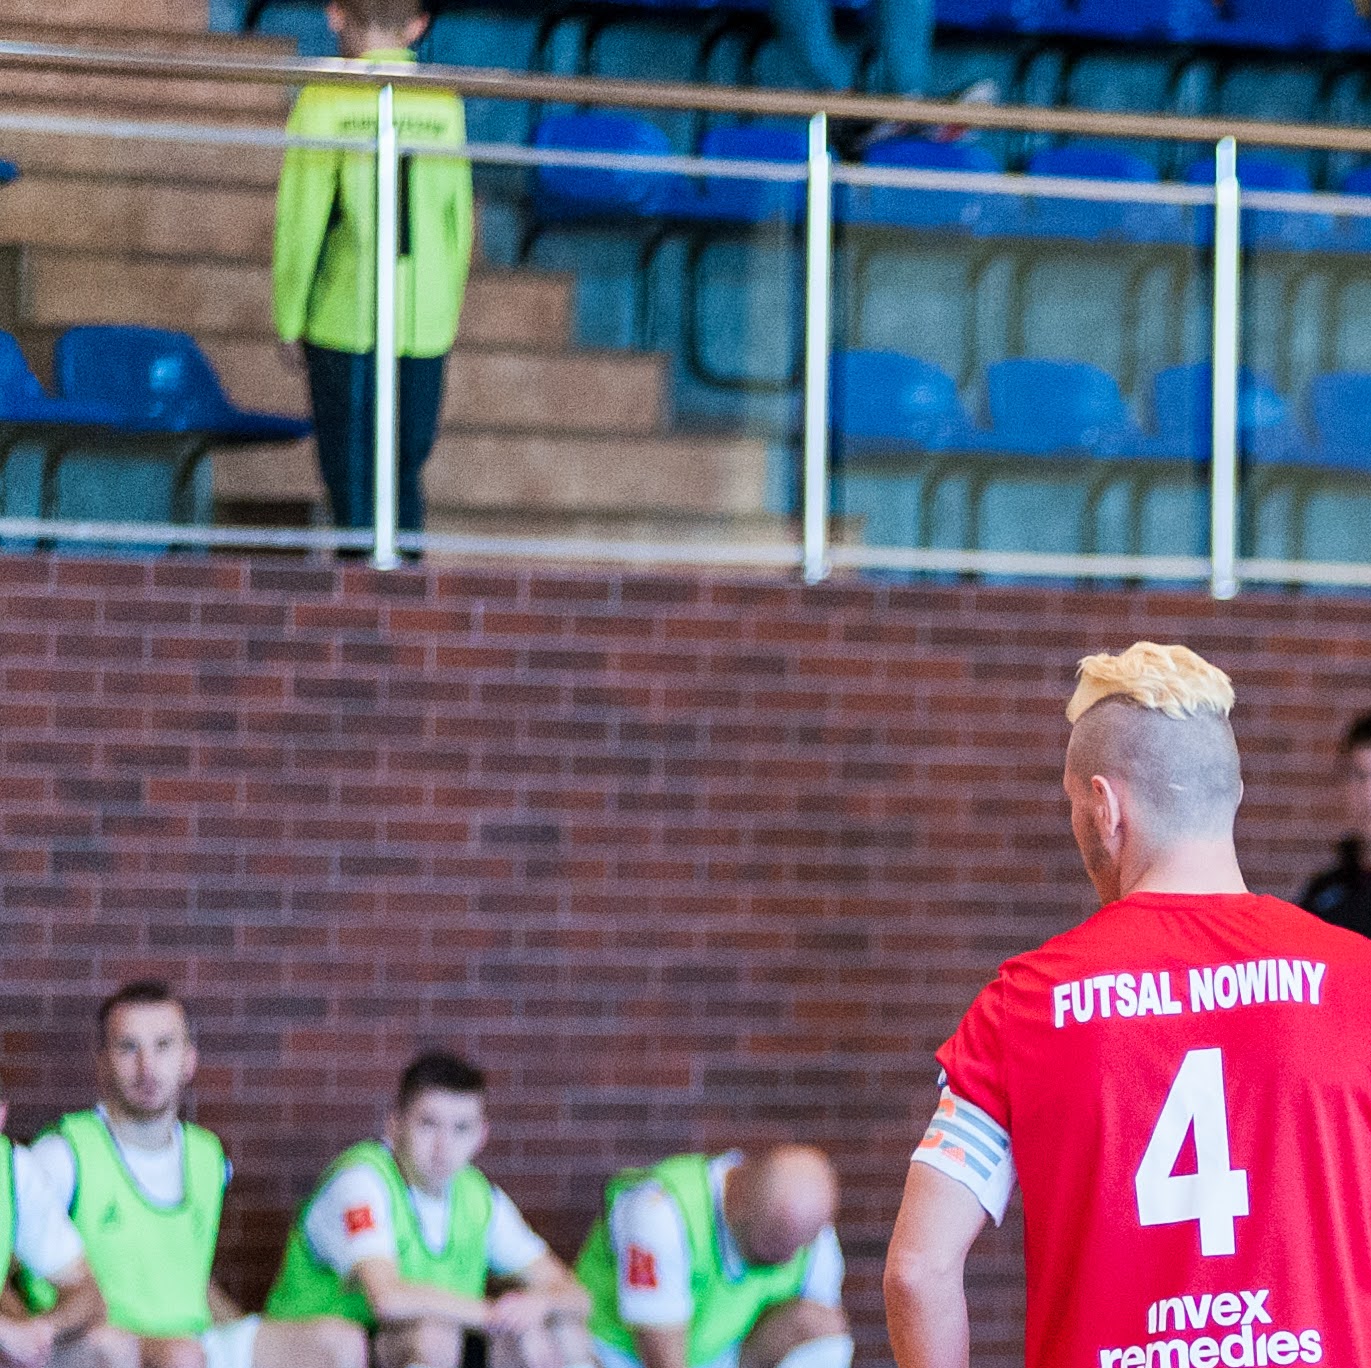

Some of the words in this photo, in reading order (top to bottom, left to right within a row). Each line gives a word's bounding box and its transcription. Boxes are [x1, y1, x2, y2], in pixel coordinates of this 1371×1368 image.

[1053, 971, 1183, 1029] FUTSAL
[1188, 958, 1326, 1013] NOWINY
[1134, 1047, 1250, 1257] 4
[1148, 1289, 1273, 1334] invex
